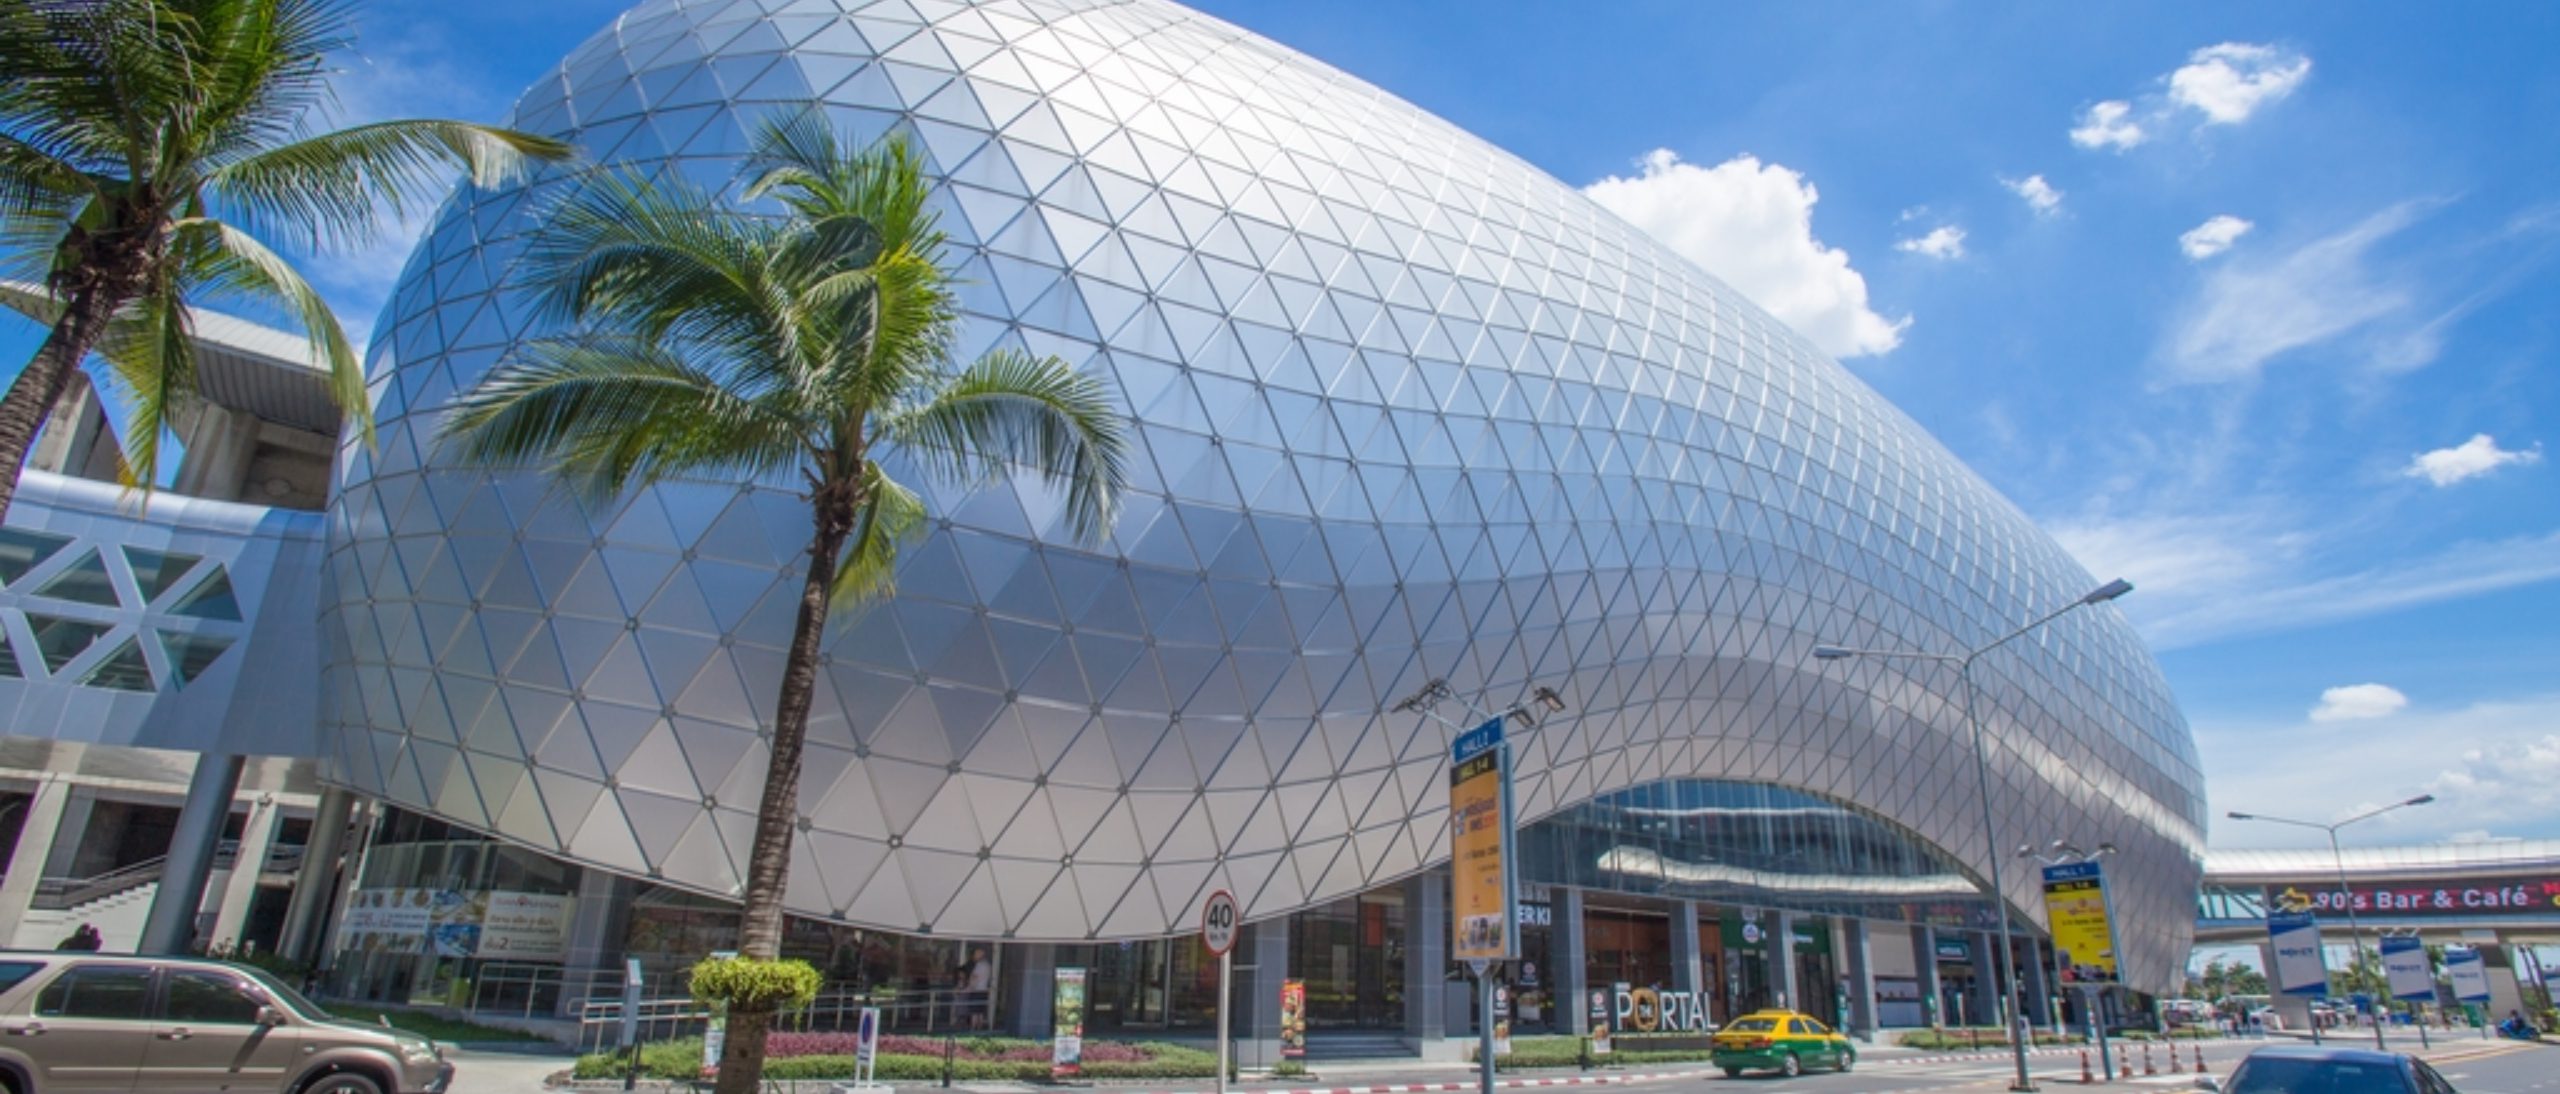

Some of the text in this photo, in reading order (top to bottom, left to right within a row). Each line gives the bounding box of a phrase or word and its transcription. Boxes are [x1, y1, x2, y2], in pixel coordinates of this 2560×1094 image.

[2376, 891, 2424, 910] Bar
[2433, 888, 2453, 909] &
[2462, 886, 2529, 907] Café
[1208, 903, 1233, 929] 40
[1616, 987, 1720, 1032] PORTAL
